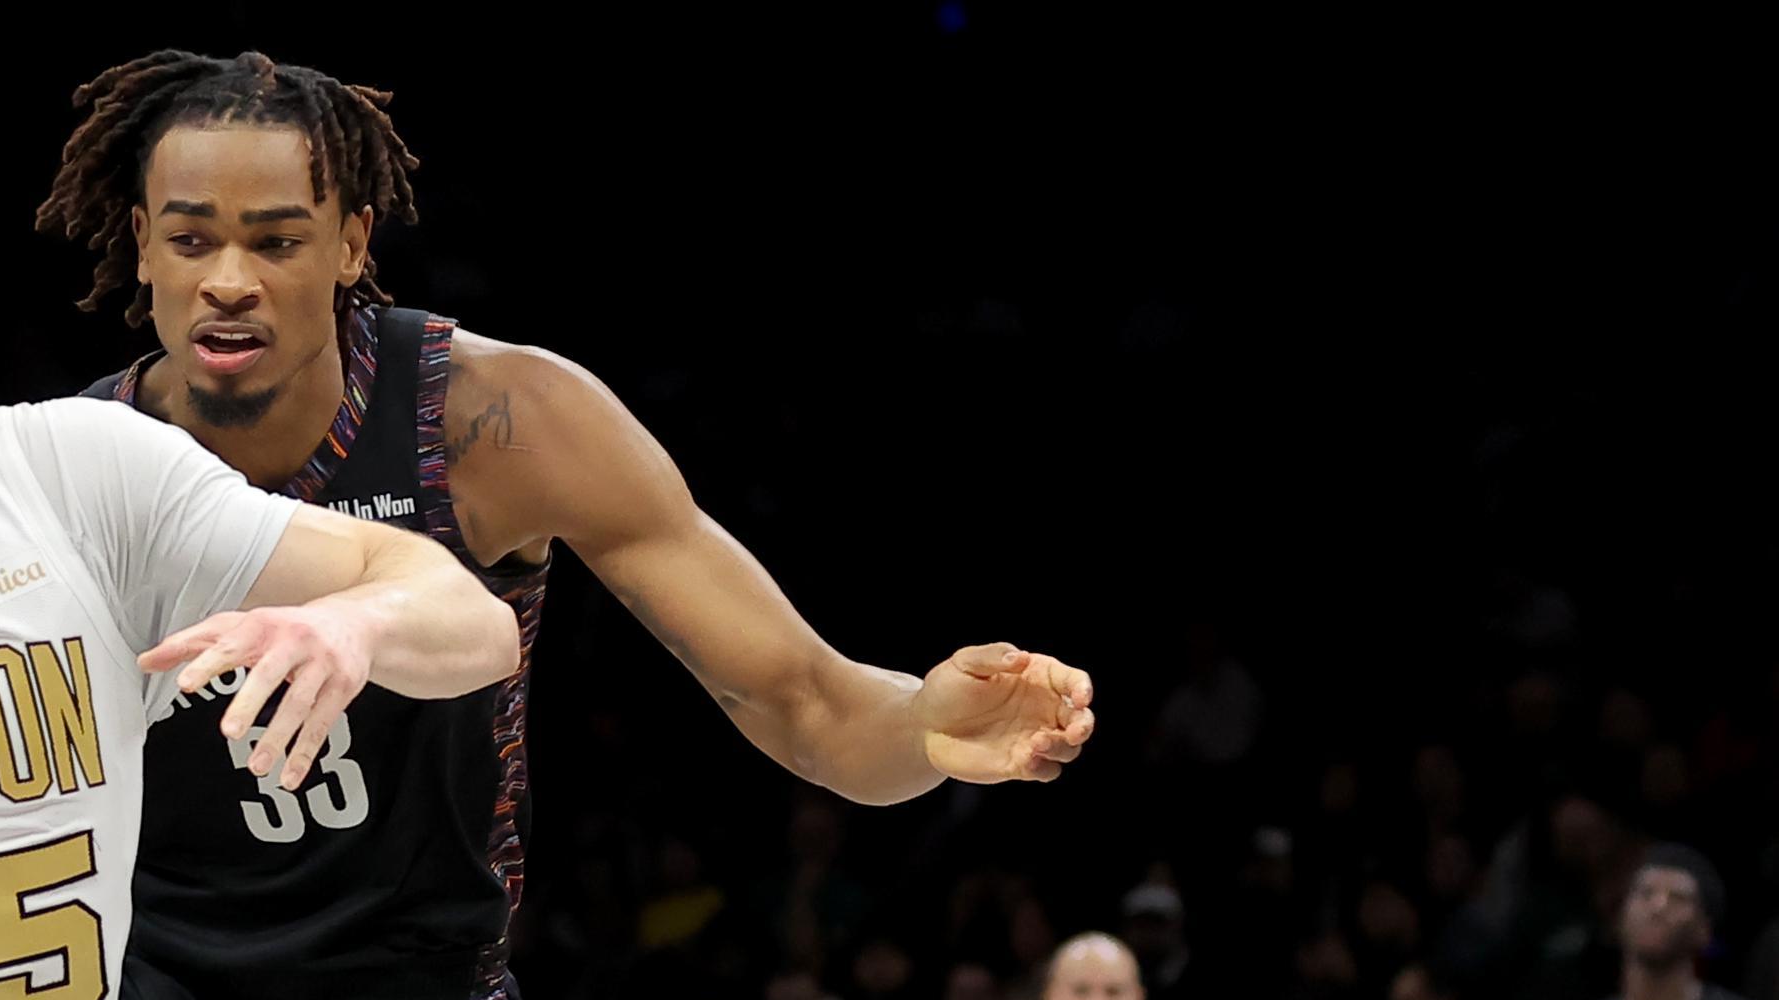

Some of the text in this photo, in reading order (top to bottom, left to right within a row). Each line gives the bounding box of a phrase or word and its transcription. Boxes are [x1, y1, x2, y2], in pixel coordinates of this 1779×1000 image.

[353, 499, 373, 520] In
[373, 493, 415, 519] Won
[227, 710, 369, 843] 33
